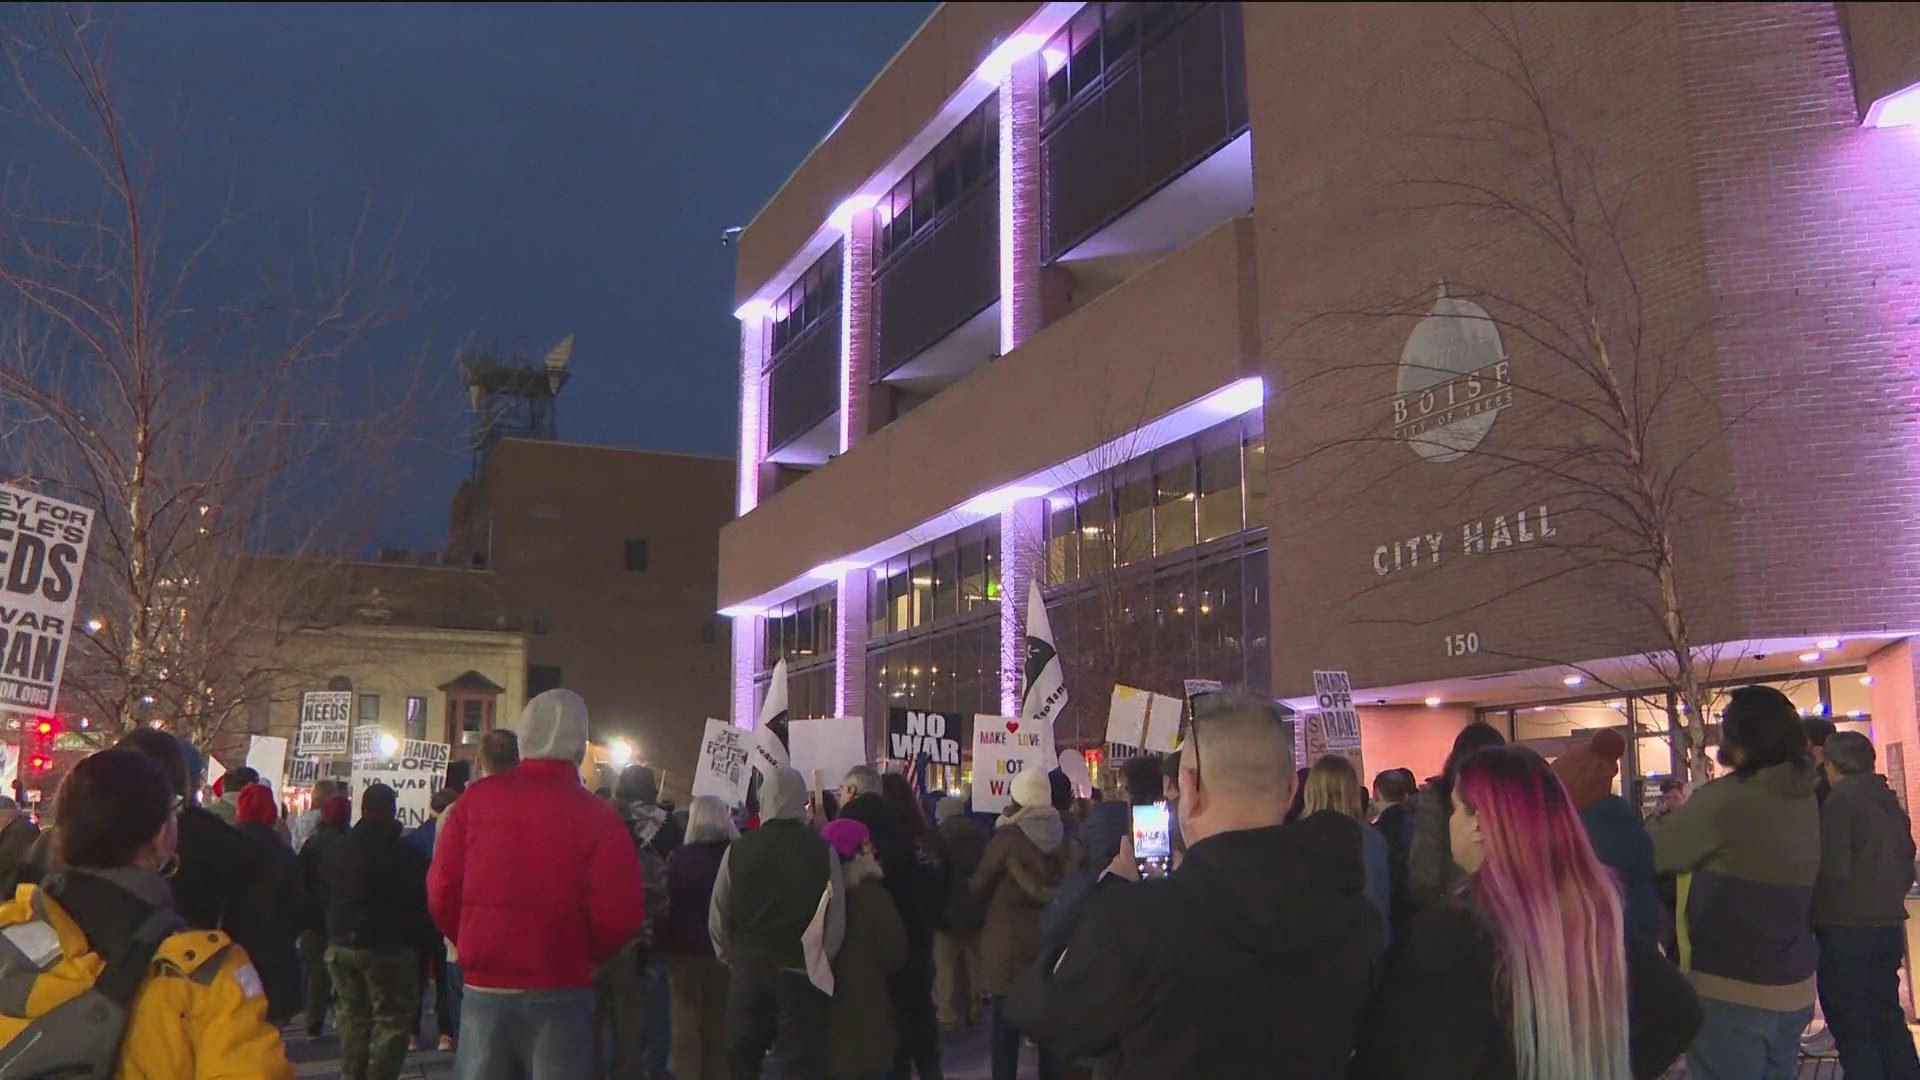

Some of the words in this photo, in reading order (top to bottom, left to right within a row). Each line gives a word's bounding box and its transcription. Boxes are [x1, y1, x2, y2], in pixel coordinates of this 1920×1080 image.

[1393, 361, 1510, 424] BOISE
[1394, 422, 1425, 440] CITY
[1438, 411, 1453, 426] OF
[1464, 392, 1513, 417] TREES
[35, 500, 88, 526] FOR
[1373, 531, 1443, 576] CITY
[1463, 505, 1557, 555] HALL
[1445, 632, 1479, 657] 150
[1315, 671, 1349, 693] HANDS
[1320, 693, 1351, 708] OFF
[304, 703, 348, 721] NEEDS
[906, 710, 946, 738] NO
[1321, 710, 1359, 738] IRAN!
[302, 731, 318, 745] W/
[321, 731, 346, 744] IRAN
[891, 733, 959, 764] WAR
[980, 730, 1007, 745] MAKE
[1018, 733, 1041, 747] LOVE
[404, 740, 449, 761] HANDS
[402, 758, 447, 773] OFF
[996, 759, 1023, 774] NOT
[392, 778, 427, 789] WAR
